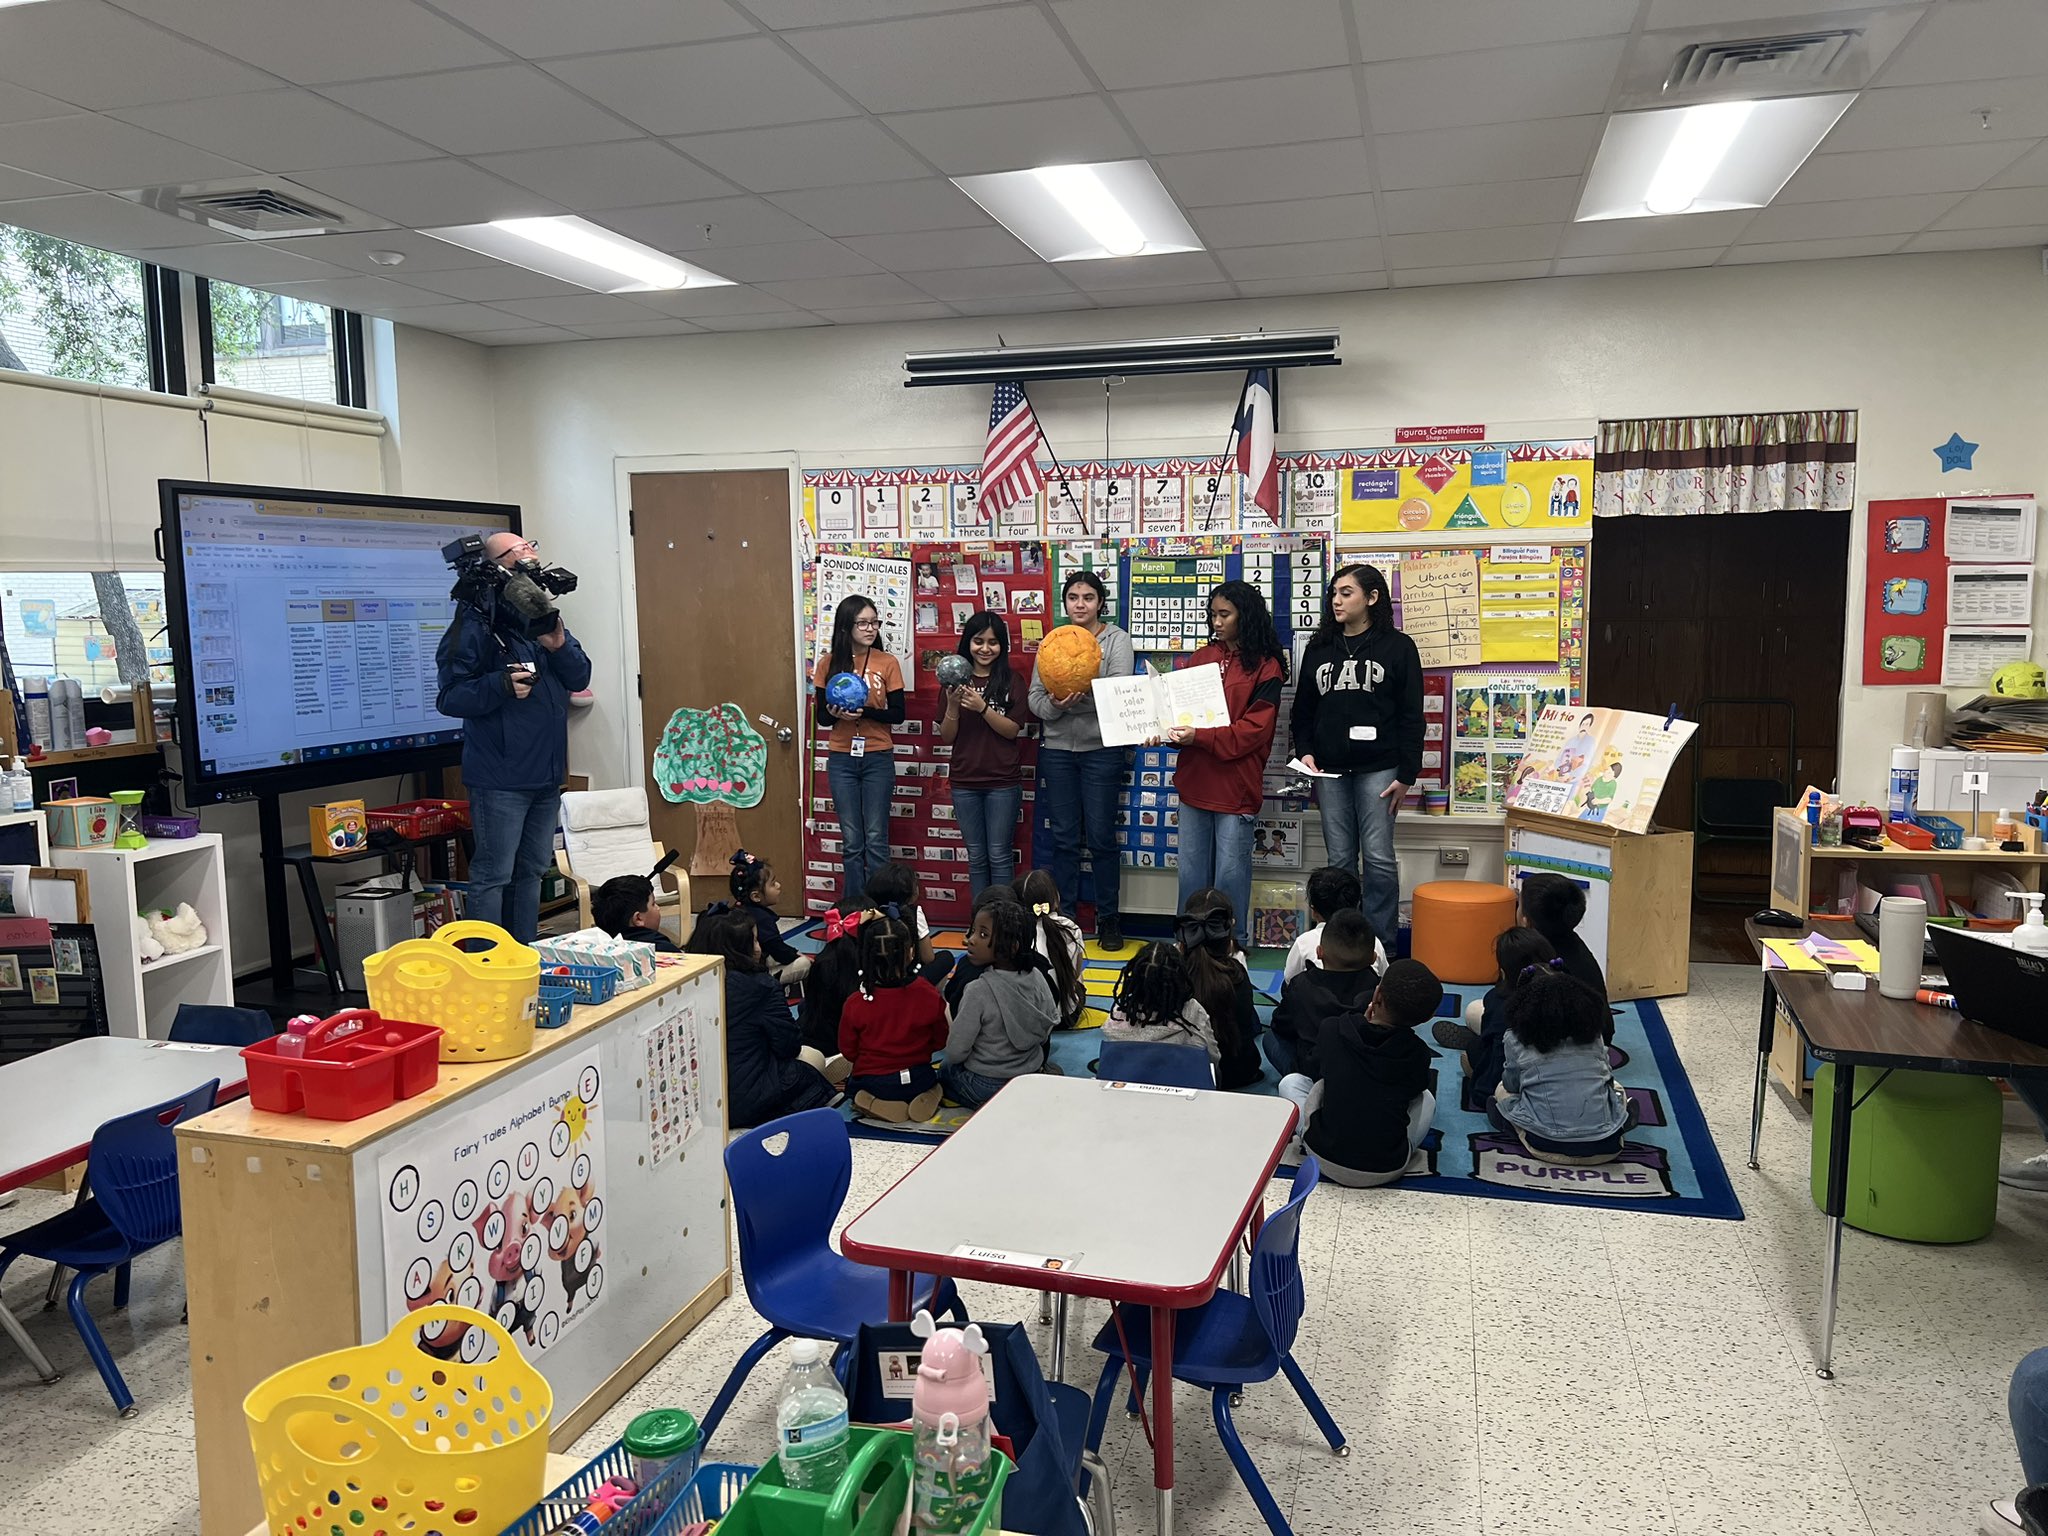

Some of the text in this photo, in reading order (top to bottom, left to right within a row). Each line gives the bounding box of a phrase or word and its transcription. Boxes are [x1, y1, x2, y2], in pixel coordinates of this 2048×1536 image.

[1397, 426, 1483, 438] Figuras Geométricas
[1306, 474, 1325, 489] 10
[1693, 476, 1704, 489] R
[1806, 469, 1817, 484] V
[1835, 471, 1846, 485] S
[1060, 482, 1070, 497] 5
[1108, 481, 1118, 495] 6
[1157, 480, 1168, 494] 7
[1207, 478, 1217, 492] 8
[831, 491, 841, 504] 0
[877, 488, 884, 502] 1
[921, 488, 930, 502] 2
[967, 486, 975, 500] 3
[1644, 489, 1656, 506] Y
[1707, 487, 1718, 504] Y
[1055, 525, 1075, 534] five
[1106, 525, 1120, 533] six
[1148, 524, 1176, 532] seven
[1252, 520, 1273, 529] nine
[1306, 518, 1324, 528] ten
[959, 528, 986, 537] three
[1008, 527, 1029, 536] four
[823, 559, 908, 575] SONIDOS INICIALES
[1257, 555, 1260, 567] 1
[1301, 554, 1310, 566] 6
[1403, 561, 1439, 573] Palabras
[1141, 562, 1220, 573] March 2024
[1253, 570, 1262, 582] 2
[1302, 570, 1312, 582] 7
[1419, 569, 1473, 583] Ubicación
[1303, 585, 1311, 597] 8
[1403, 591, 1434, 600] arriba
[1301, 600, 1310, 612] 9
[1404, 605, 1430, 615] debajo
[1299, 615, 1313, 627] 10
[1406, 621, 1438, 630] enfrente
[1315, 659, 1385, 696] GAP
[1114, 686, 1131, 696] How
[1489, 683, 1536, 691] CONEJITOS
[1124, 697, 1145, 706] solar
[1119, 709, 1146, 718] eclipses
[1542, 709, 1559, 721] Mi
[94, 806, 107, 814] like
[1278, 820, 1298, 830] TALK
[585, 1078, 592, 1093] E
[1139, 1085, 1183, 1093] Adriana
[454, 1089, 571, 1162] Fairy Tales Alphabet Bump
[556, 1129, 563, 1145] X
[525, 1151, 531, 1167] U
[577, 1163, 584, 1177] G
[1495, 1162, 1649, 1185] PURPLE
[494, 1171, 501, 1187] C
[400, 1180, 409, 1198] H
[539, 1188, 546, 1203] Y
[462, 1192, 469, 1208] Q
[427, 1211, 435, 1228] S
[589, 1210, 598, 1223] M
[488, 1221, 500, 1238] W
[555, 1226, 563, 1239] V
[457, 1244, 466, 1259] K
[527, 1244, 534, 1259] P
[580, 1248, 588, 1263] F
[968, 1249, 1007, 1260] Luisa
[413, 1272, 421, 1289] A
[592, 1272, 598, 1287] J
[465, 1286, 473, 1301] T
[500, 1313, 508, 1328] O
[545, 1322, 551, 1337] L
[468, 1334, 475, 1351] R
